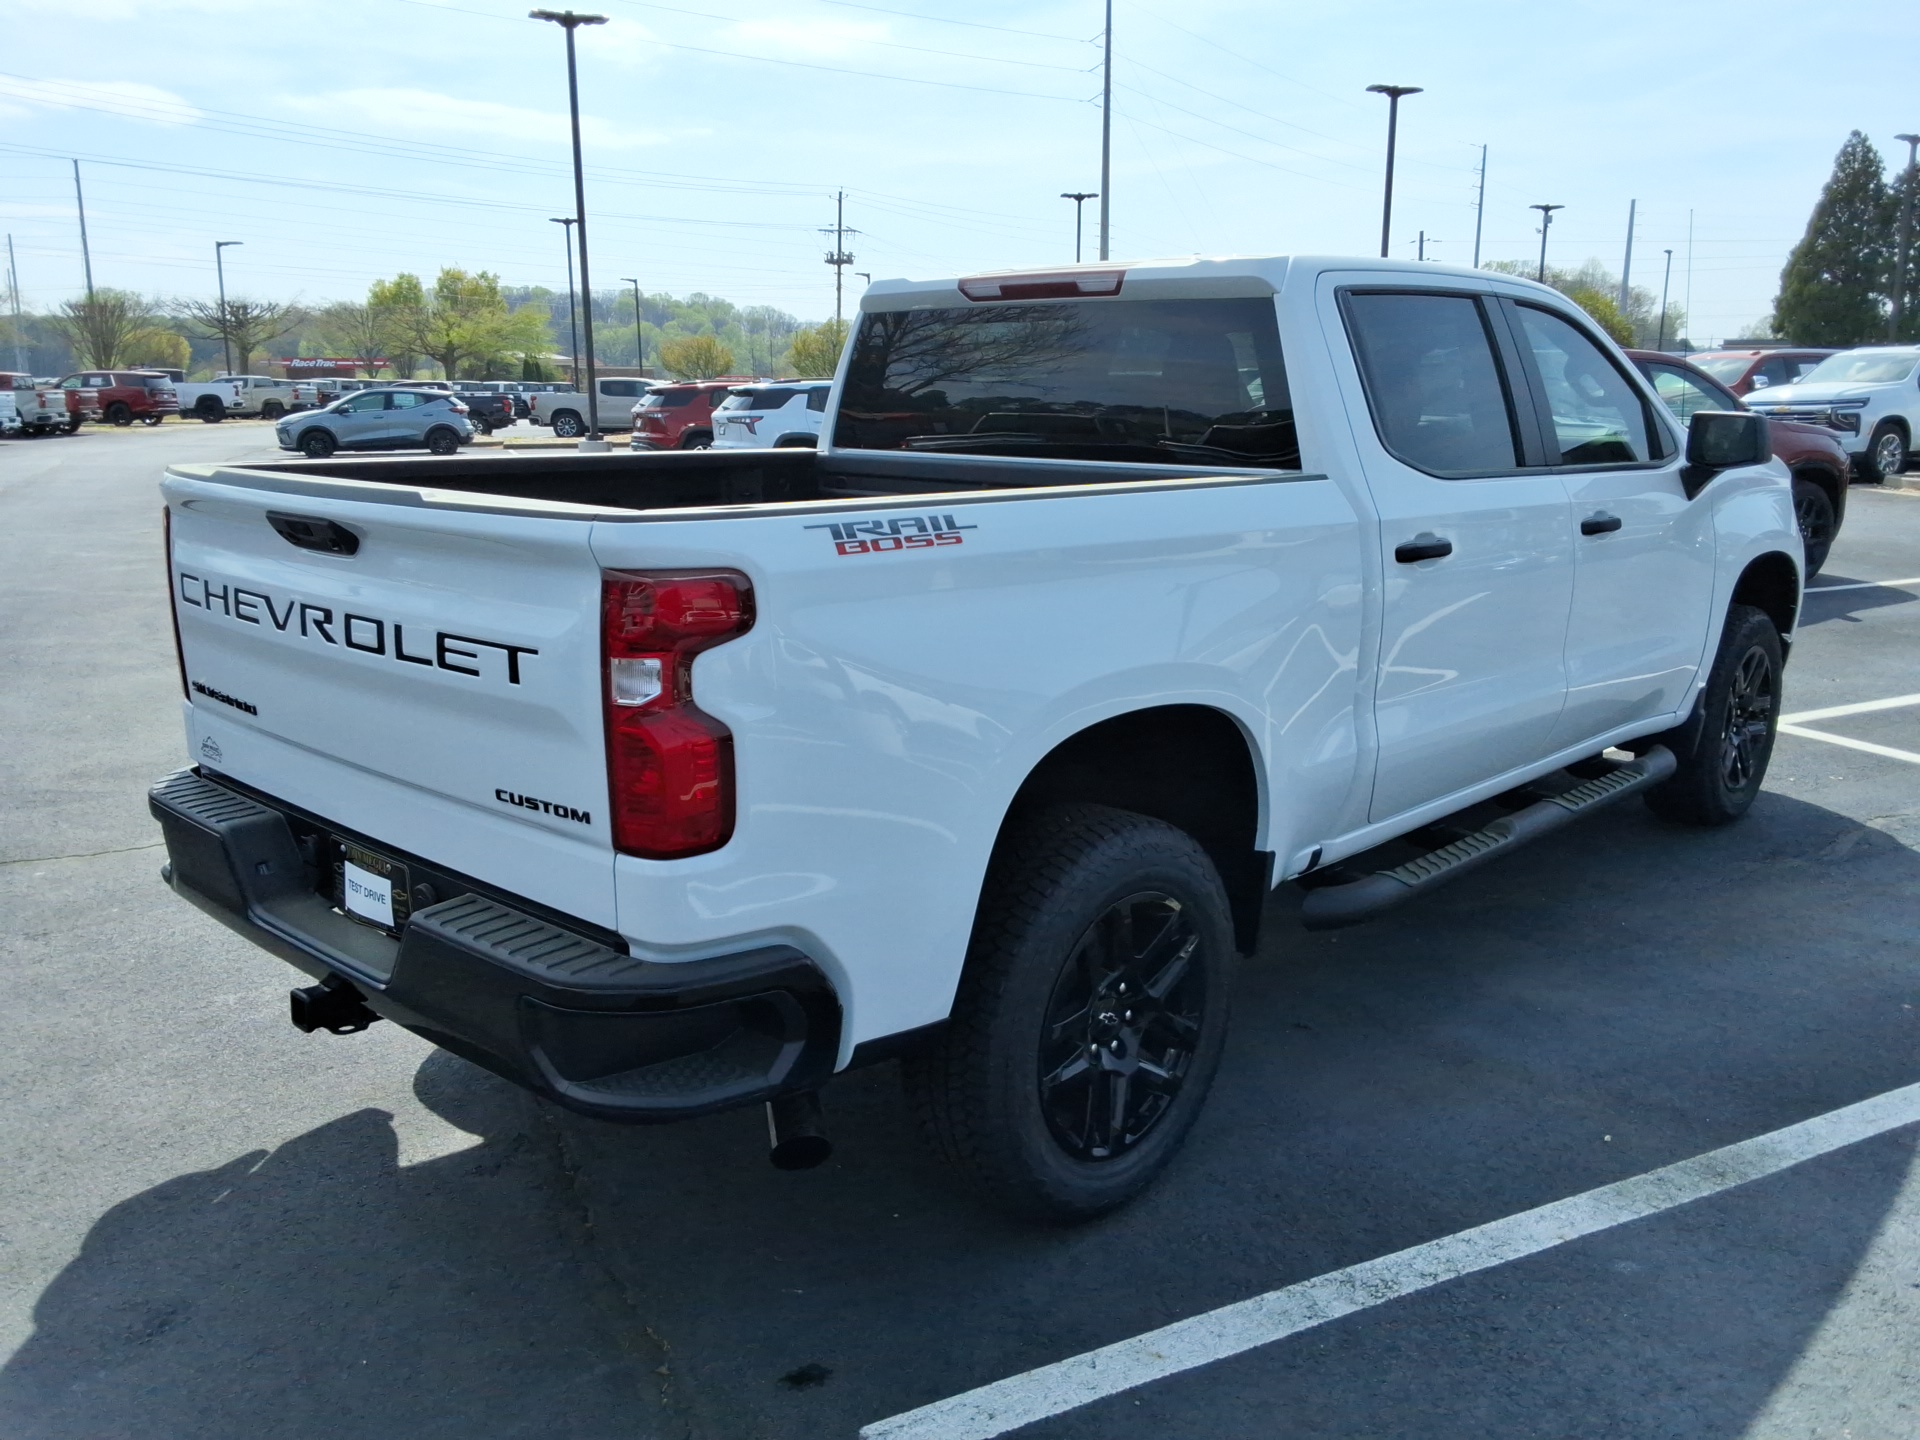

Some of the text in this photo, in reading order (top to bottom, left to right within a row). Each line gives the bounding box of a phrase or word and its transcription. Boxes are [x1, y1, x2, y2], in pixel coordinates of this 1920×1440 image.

[291, 359, 336, 367] RaceTrac
[803, 514, 978, 541] TRAIL
[834, 531, 963, 556] BOSS
[180, 571, 539, 685] CHEVROLET
[495, 788, 591, 825] CUSTOM
[348, 878, 386, 905] TEST DRIVE
